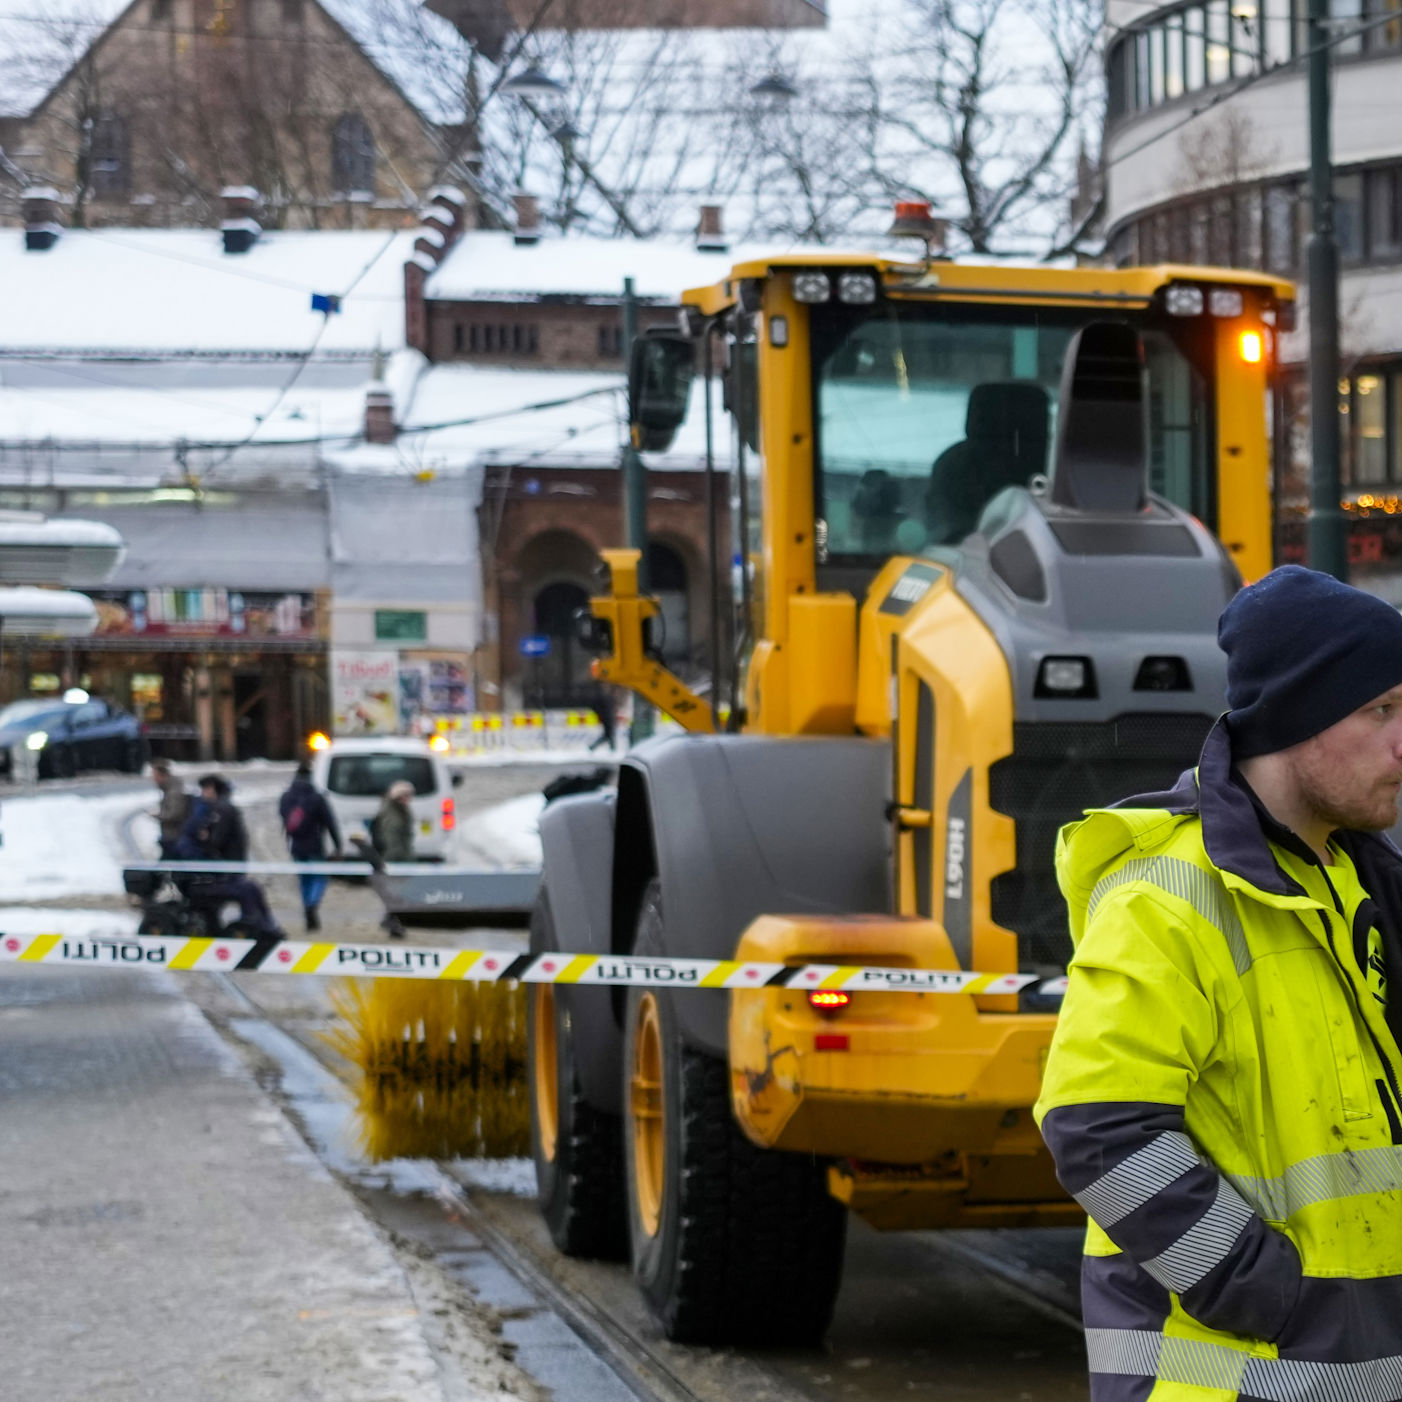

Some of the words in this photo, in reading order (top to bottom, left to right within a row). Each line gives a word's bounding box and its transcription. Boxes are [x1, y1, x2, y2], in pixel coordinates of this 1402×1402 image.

[63, 941, 166, 962] POLITI
[338, 949, 439, 968] POLITI
[597, 964, 698, 982] POLITI
